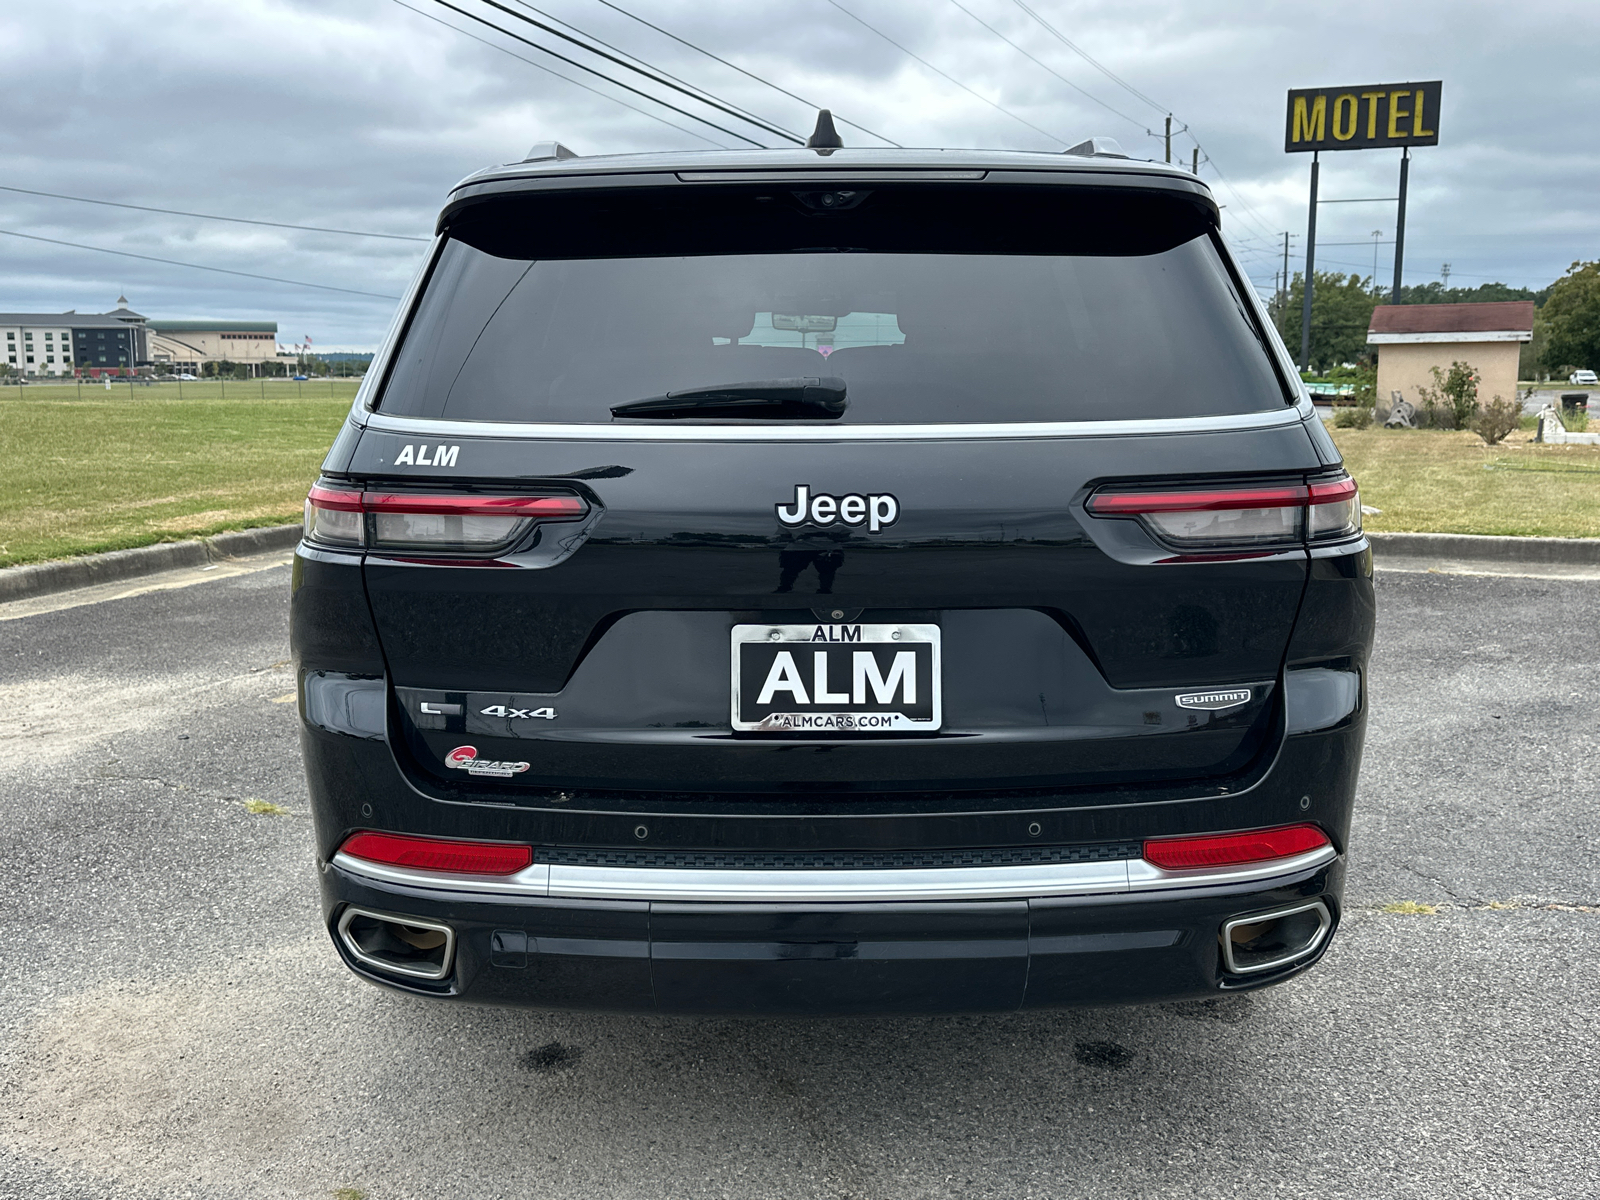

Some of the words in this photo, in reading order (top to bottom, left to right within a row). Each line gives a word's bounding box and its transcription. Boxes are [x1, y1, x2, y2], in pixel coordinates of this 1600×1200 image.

[1291, 89, 1434, 143] MOTEL
[394, 444, 460, 467] ALM
[777, 486, 898, 532] Jeep
[811, 625, 862, 642] ALM
[756, 651, 917, 705] ALM
[1181, 692, 1248, 705] SUMMIT
[480, 705, 558, 720] 4x4
[782, 715, 892, 727] ALMCARS.COM
[461, 759, 526, 772] GIRARD
